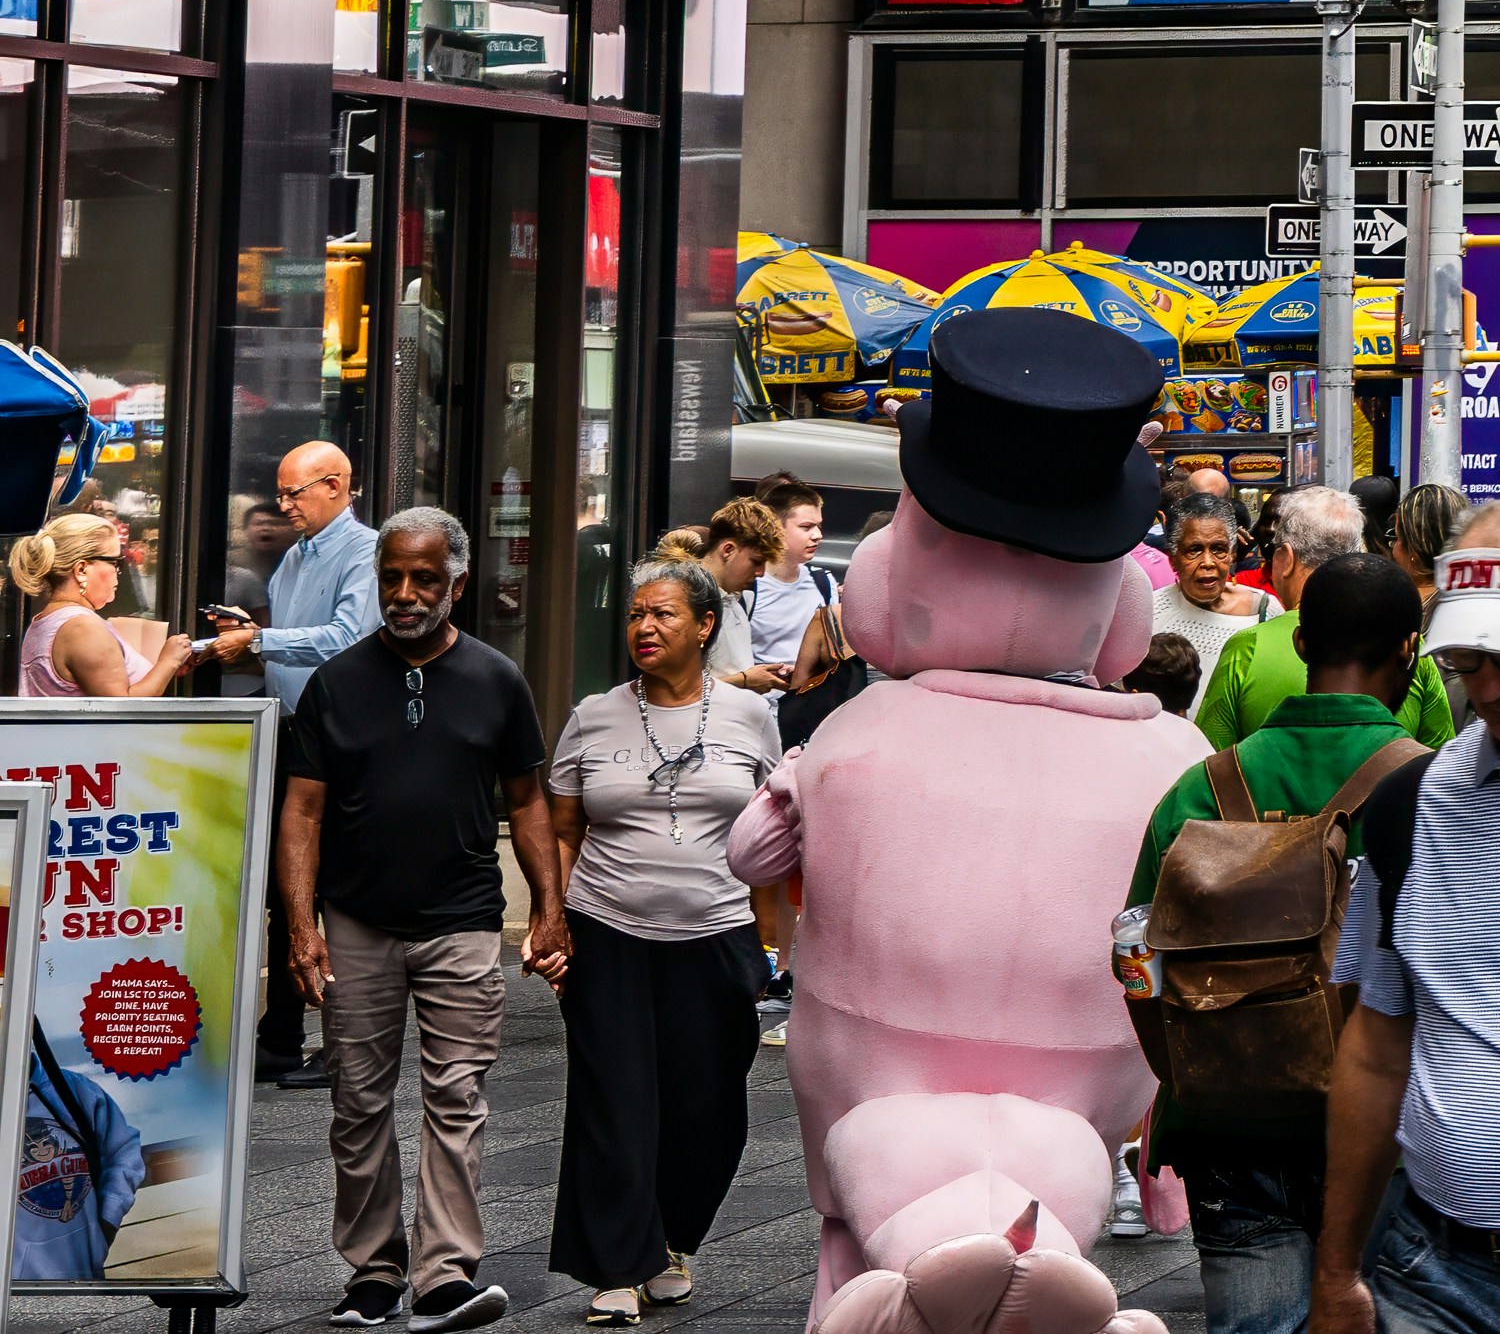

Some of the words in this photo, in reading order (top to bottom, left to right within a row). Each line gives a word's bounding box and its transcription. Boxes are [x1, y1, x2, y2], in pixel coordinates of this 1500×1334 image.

[1380, 123, 1434, 148] ONE
[1284, 221, 1321, 241] ONE
[1353, 221, 1394, 241] WAY
[62, 906, 183, 940] SHOP!
[112, 980, 142, 988] MAMA
